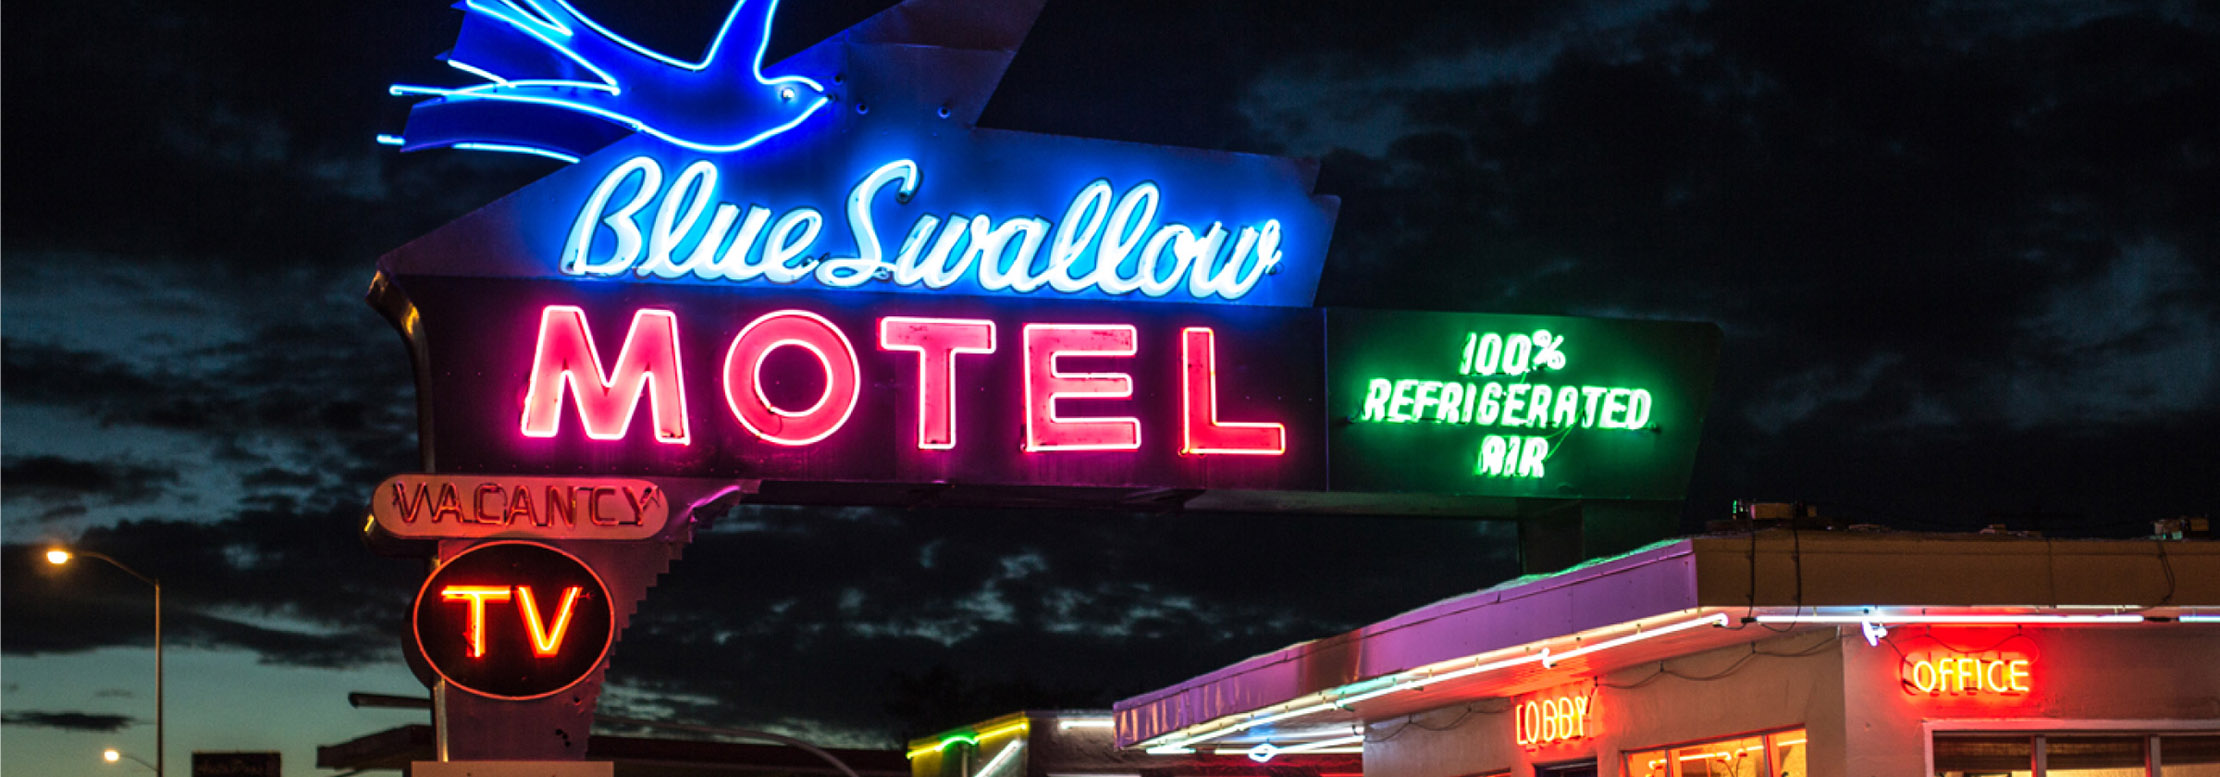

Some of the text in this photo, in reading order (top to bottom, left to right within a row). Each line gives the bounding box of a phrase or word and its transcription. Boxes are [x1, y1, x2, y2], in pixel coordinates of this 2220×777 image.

[559, 156, 1284, 300] Blue Swallow
[1459, 329, 1566, 375] 100%
[521, 306, 1287, 455] MOTEL
[1361, 378, 1652, 429] REFRIGERATED
[1476, 434, 1549, 478] AIR
[392, 481, 660, 525] VACANCY
[441, 584, 582, 658] TV
[1913, 658, 2030, 692] OFFICE
[1515, 695, 1588, 745] LOBBY
